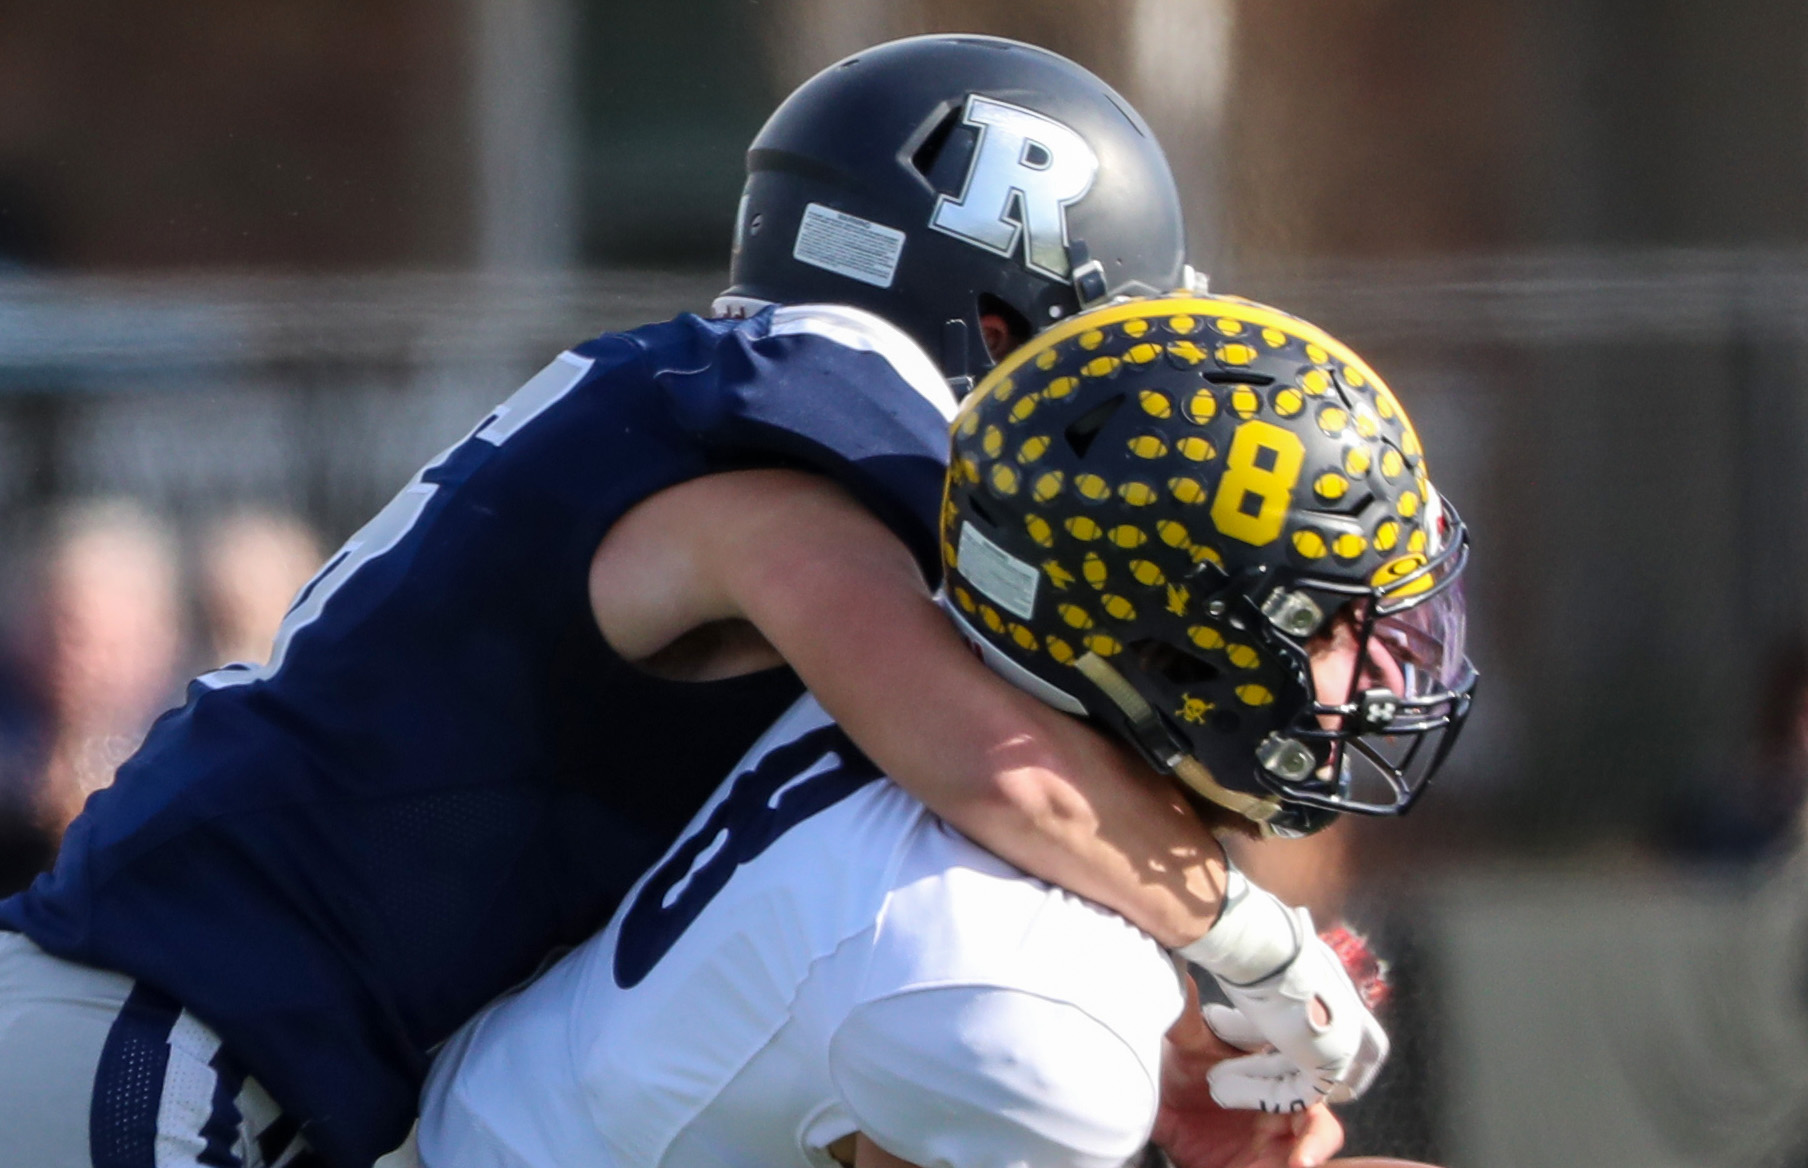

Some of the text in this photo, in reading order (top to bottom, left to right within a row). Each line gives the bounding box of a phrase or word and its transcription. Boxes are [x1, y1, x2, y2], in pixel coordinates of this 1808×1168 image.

[928, 93, 1100, 286] R
[1210, 419, 1306, 547] 8
[612, 720, 890, 991] 8
